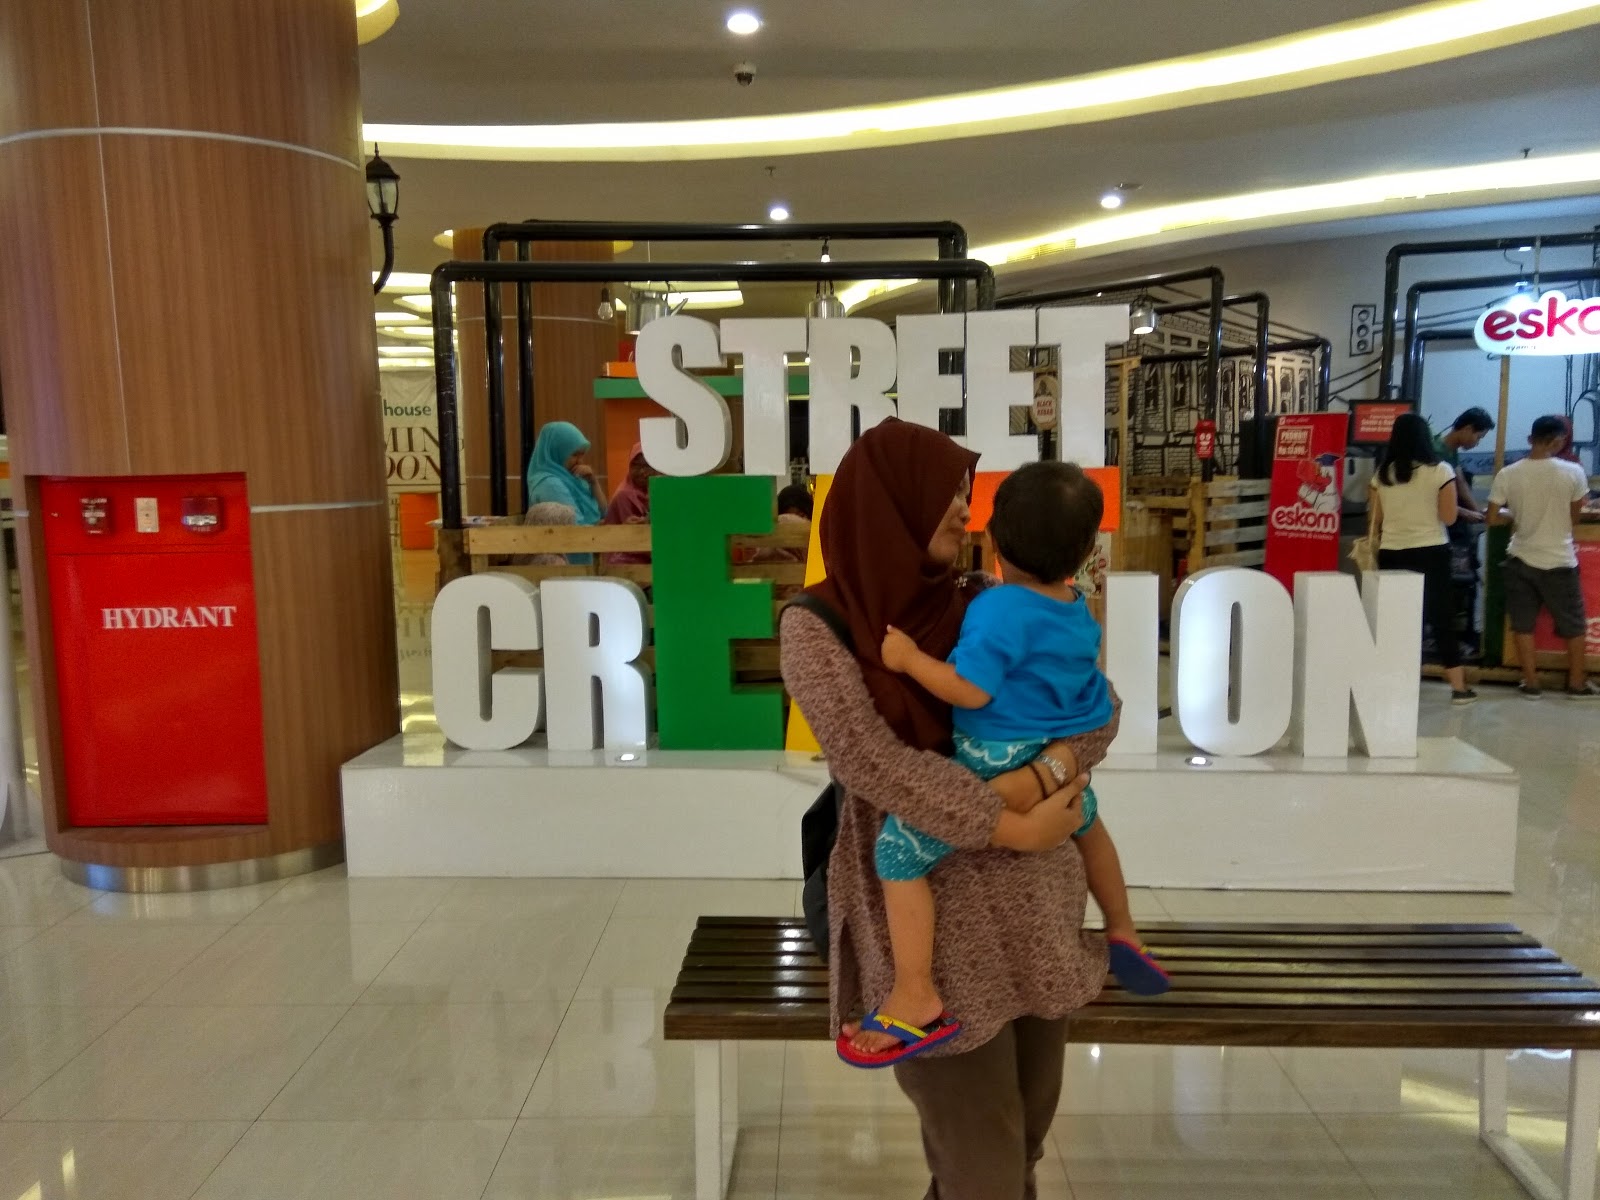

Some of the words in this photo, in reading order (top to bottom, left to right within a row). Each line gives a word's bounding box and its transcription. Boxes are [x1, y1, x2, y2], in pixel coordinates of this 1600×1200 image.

[635, 304, 1131, 477] STREET
[383, 399, 432, 416] house
[1274, 503, 1337, 531] eskom
[100, 606, 237, 629] HYDRANT
[430, 475, 1425, 759] CREION
